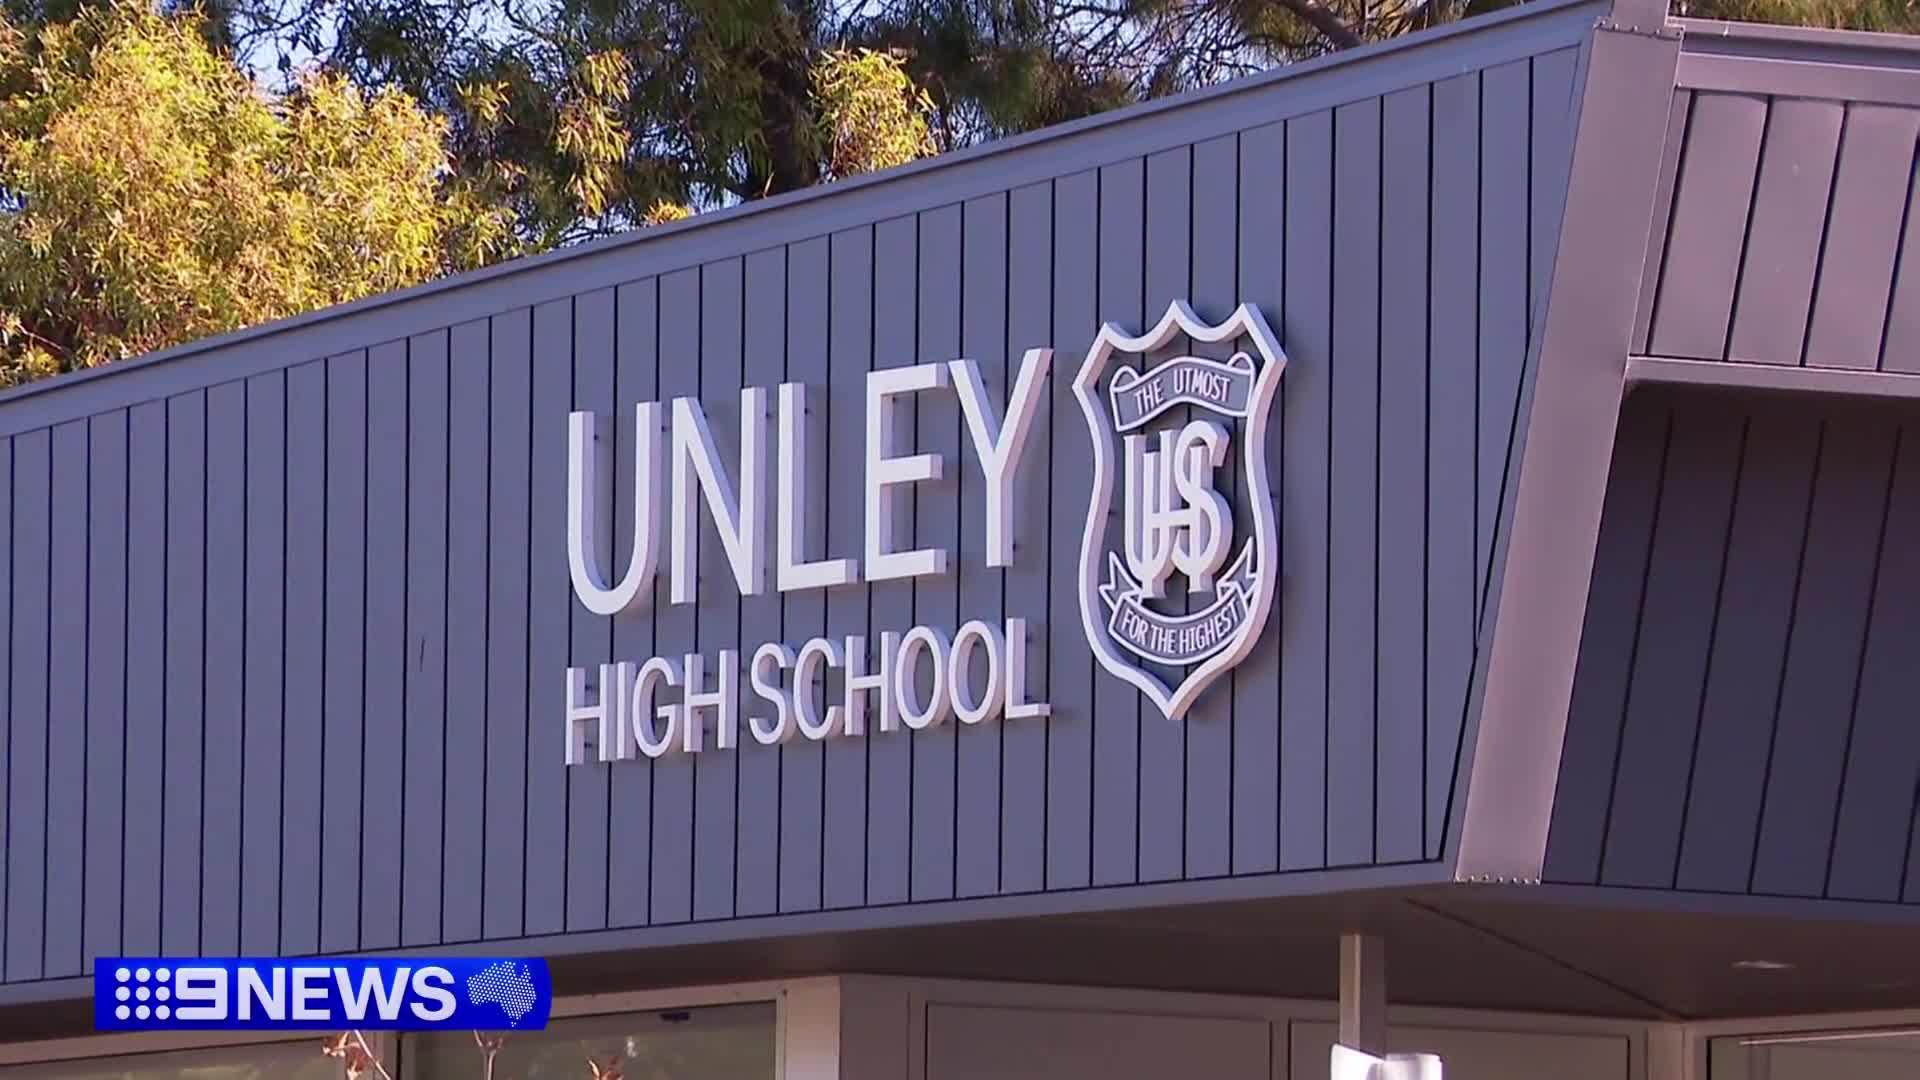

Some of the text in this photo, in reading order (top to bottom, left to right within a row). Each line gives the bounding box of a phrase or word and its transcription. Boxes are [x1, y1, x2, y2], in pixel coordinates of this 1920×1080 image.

[1134, 367, 1231, 416] THE UTMOST
[567, 347, 1054, 615] UNLEY
[1121, 596, 1240, 655] FOR THE HIGHEST
[565, 617, 1052, 766] HIGH SCHOOL
